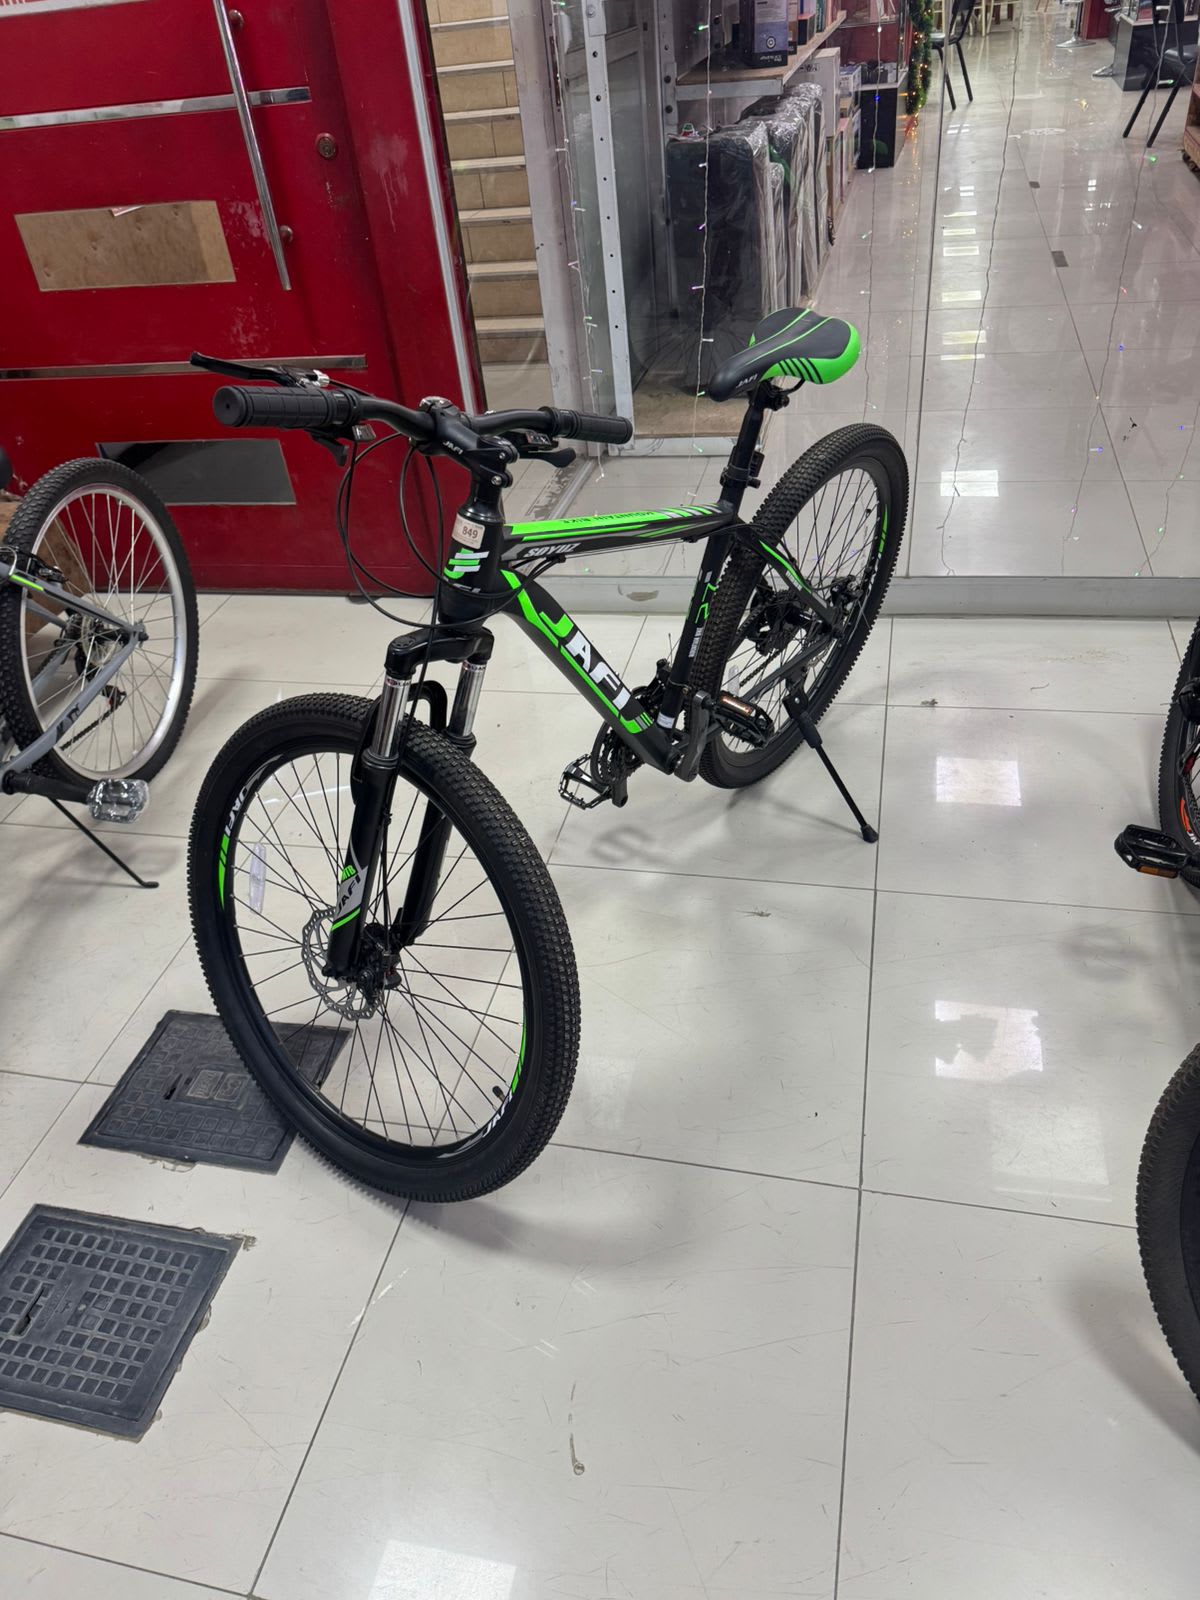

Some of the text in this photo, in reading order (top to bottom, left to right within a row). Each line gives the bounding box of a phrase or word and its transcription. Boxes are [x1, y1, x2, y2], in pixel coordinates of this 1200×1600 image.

[442, 441, 464, 455] JAFI
[462, 526, 479, 538] 849
[523, 542, 581, 558] SOYUZ
[539, 611, 631, 710] JAFI
[224, 786, 246, 837] JAFI
[337, 874, 361, 916] JAFI
